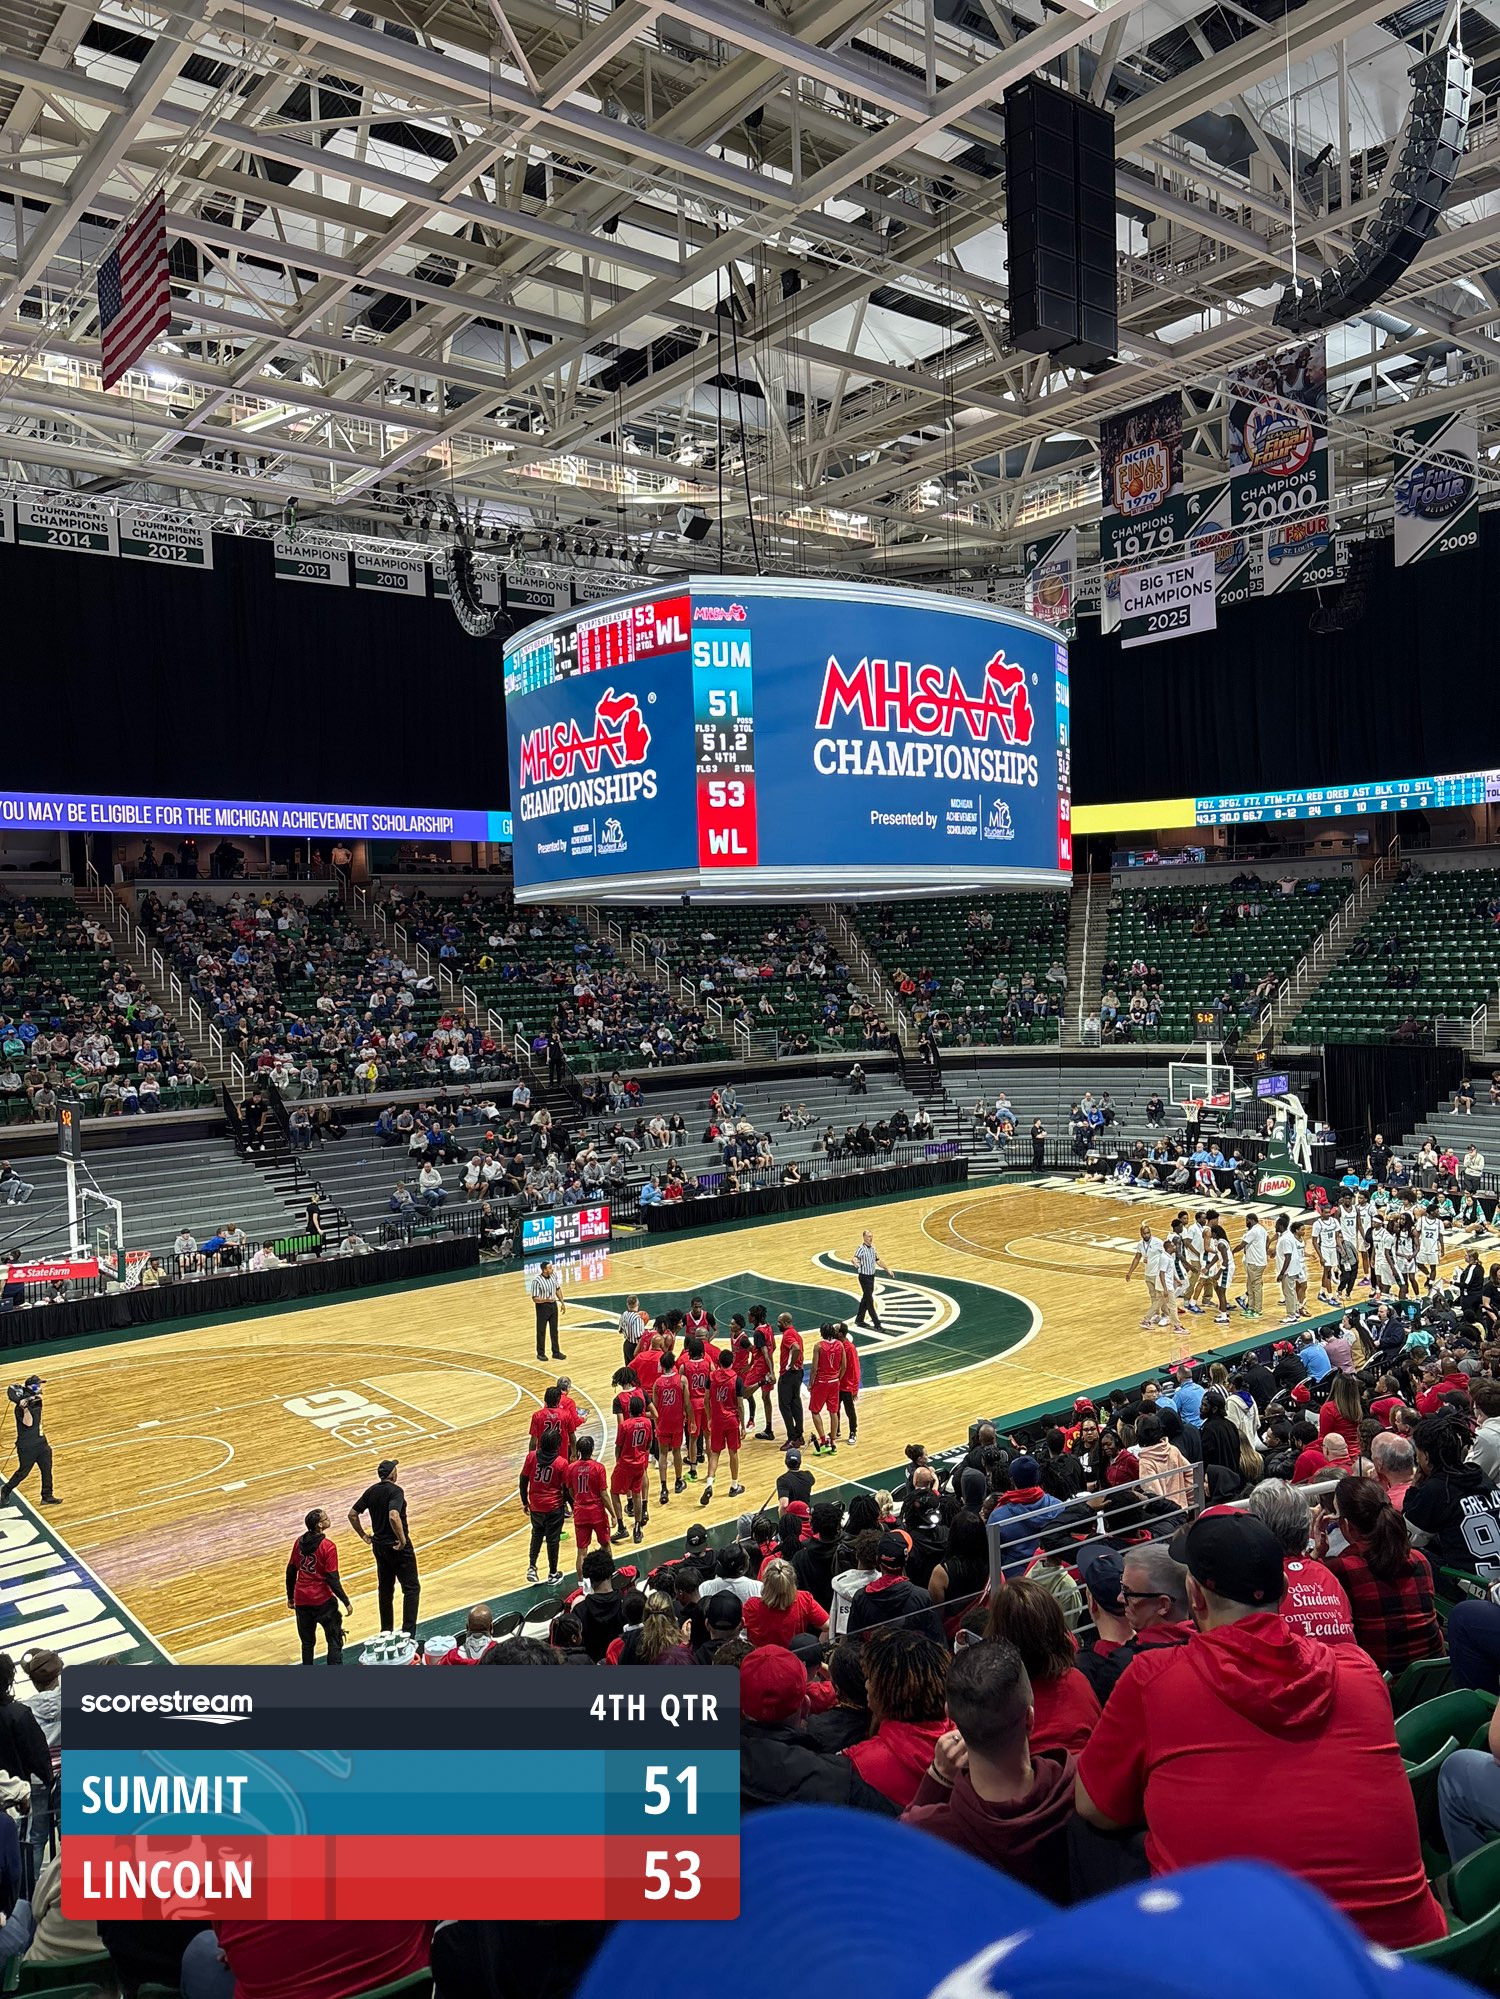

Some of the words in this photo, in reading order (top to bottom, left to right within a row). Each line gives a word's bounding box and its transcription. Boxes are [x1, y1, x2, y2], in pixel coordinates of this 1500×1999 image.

[1124, 446, 1154, 464] NCAA
[1119, 454, 1164, 482] FINAL
[1241, 470, 1316, 501] CHAMPIONS
[1409, 479, 1464, 508] FOUR
[1127, 492, 1157, 509] 1979
[1242, 484, 1318, 525] 2000
[30, 514, 108, 533] CHAMPIONS
[1112, 514, 1174, 540] CHAMPIONS
[47, 530, 92, 548] 2014
[132, 528, 204, 546] CHAMPIONS
[1114, 526, 1174, 560] 1979
[1440, 532, 1478, 552] 2009
[148, 544, 188, 562] 2012
[276, 544, 346, 562] CHAMPIONS
[298, 564, 328, 578] 2012
[357, 555, 424, 572] CHAMPIONS
[1040, 564, 1061, 576] NCAA
[376, 574, 406, 587] 2010
[508, 576, 569, 592] CHAMPIONS
[1140, 572, 1163, 592] BIG
[1168, 566, 1194, 584] TEN
[1302, 566, 1334, 584] 2005
[526, 592, 553, 605] 2001
[1125, 580, 1212, 612] CHAMPIONS
[1221, 588, 1248, 604] 2001
[635, 604, 654, 626] 53
[1148, 609, 1188, 632] 2025
[656, 616, 688, 646] WL
[554, 632, 578, 656] 51.2
[694, 641, 752, 668] SUM
[708, 690, 738, 716] 51
[815, 654, 1014, 743] MHSAA
[520, 712, 630, 789] MHSAA
[702, 734, 748, 751] 51.2
[715, 752, 737, 762] 4TH
[814, 738, 1038, 787] CHAMPIONSHIPS
[520, 769, 658, 822] CHAMPIONSHIPS
[708, 781, 745, 808] 53
[950, 798, 973, 808] MICHIGAN
[1198, 801, 1214, 810] FG%
[1218, 798, 1240, 808] 3FG%
[1244, 796, 1260, 806] FT%
[1264, 794, 1304, 805] FTM-FTA
[1306, 792, 1323, 800] REB
[1326, 789, 1349, 800] OREB
[1352, 787, 1370, 797] AST
[1375, 784, 1393, 796] BLK
[1398, 783, 1410, 793] TO
[1414, 781, 1432, 792] STL
[28, 802, 63, 822] MAY
[68, 803, 86, 822] BE
[90, 804, 152, 824] ELIGIBLE
[156, 806, 182, 825] FOR
[186, 807, 212, 826] THE
[215, 808, 278, 828] MICHIGAN
[282, 811, 368, 831] ACHIEVEMENT
[372, 814, 454, 833] SCHOLARSHIP!
[946, 812, 978, 822] ACHIEVEMENT
[1196, 814, 1216, 824] 43.2
[1220, 812, 1240, 822] 30.0
[1242, 811, 1262, 820] 66.7
[1275, 808, 1296, 818] 8-12
[1308, 806, 1321, 816] 24
[1334, 804, 1341, 814] 8
[1356, 802, 1366, 812] 10
[1381, 800, 1388, 810] 2
[1400, 798, 1408, 808] 5
[1420, 796, 1427, 806] 3
[870, 810, 924, 826] Presented
[926, 811, 938, 830] by
[946, 824, 978, 836] SCHOLARSHIP
[538, 840, 560, 854] Presented
[560, 839, 568, 852] by
[708, 828, 748, 854] WL
[1258, 1180, 1292, 1196] LIBMAN
[532, 1218, 546, 1232] 51
[554, 1212, 580, 1228] 51.2
[587, 1208, 602, 1221] 53
[594, 1222, 610, 1236] WL
[692, 1374, 705, 1388] 20
[662, 1388, 676, 1406] 23
[632, 1429, 647, 1448] 10
[578, 1474, 589, 1494] 11
[1461, 1512, 1500, 1580] 9
[1288, 1582, 1324, 1594] oday's
[1474, 1586, 1484, 1598] 14
[1293, 1592, 1340, 1608] Students
